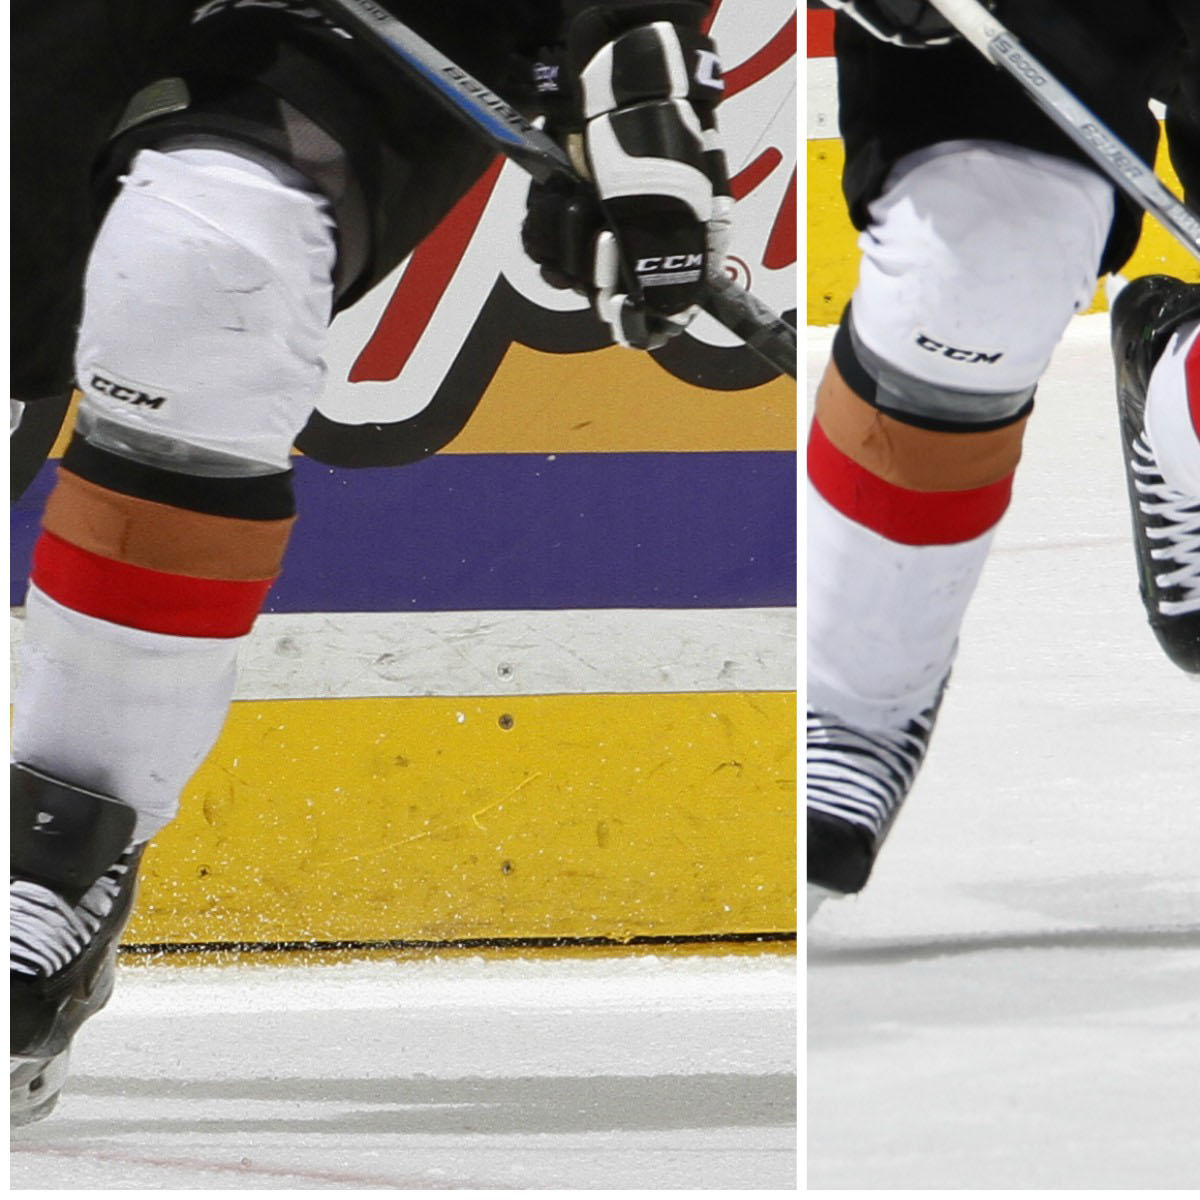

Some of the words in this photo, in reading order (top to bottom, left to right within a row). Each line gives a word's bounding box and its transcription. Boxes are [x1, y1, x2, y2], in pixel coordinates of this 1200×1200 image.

[443, 65, 534, 132] BAUER
[633, 253, 703, 273] CCM
[916, 333, 1004, 364] CCM
[91, 375, 167, 409] CCM
